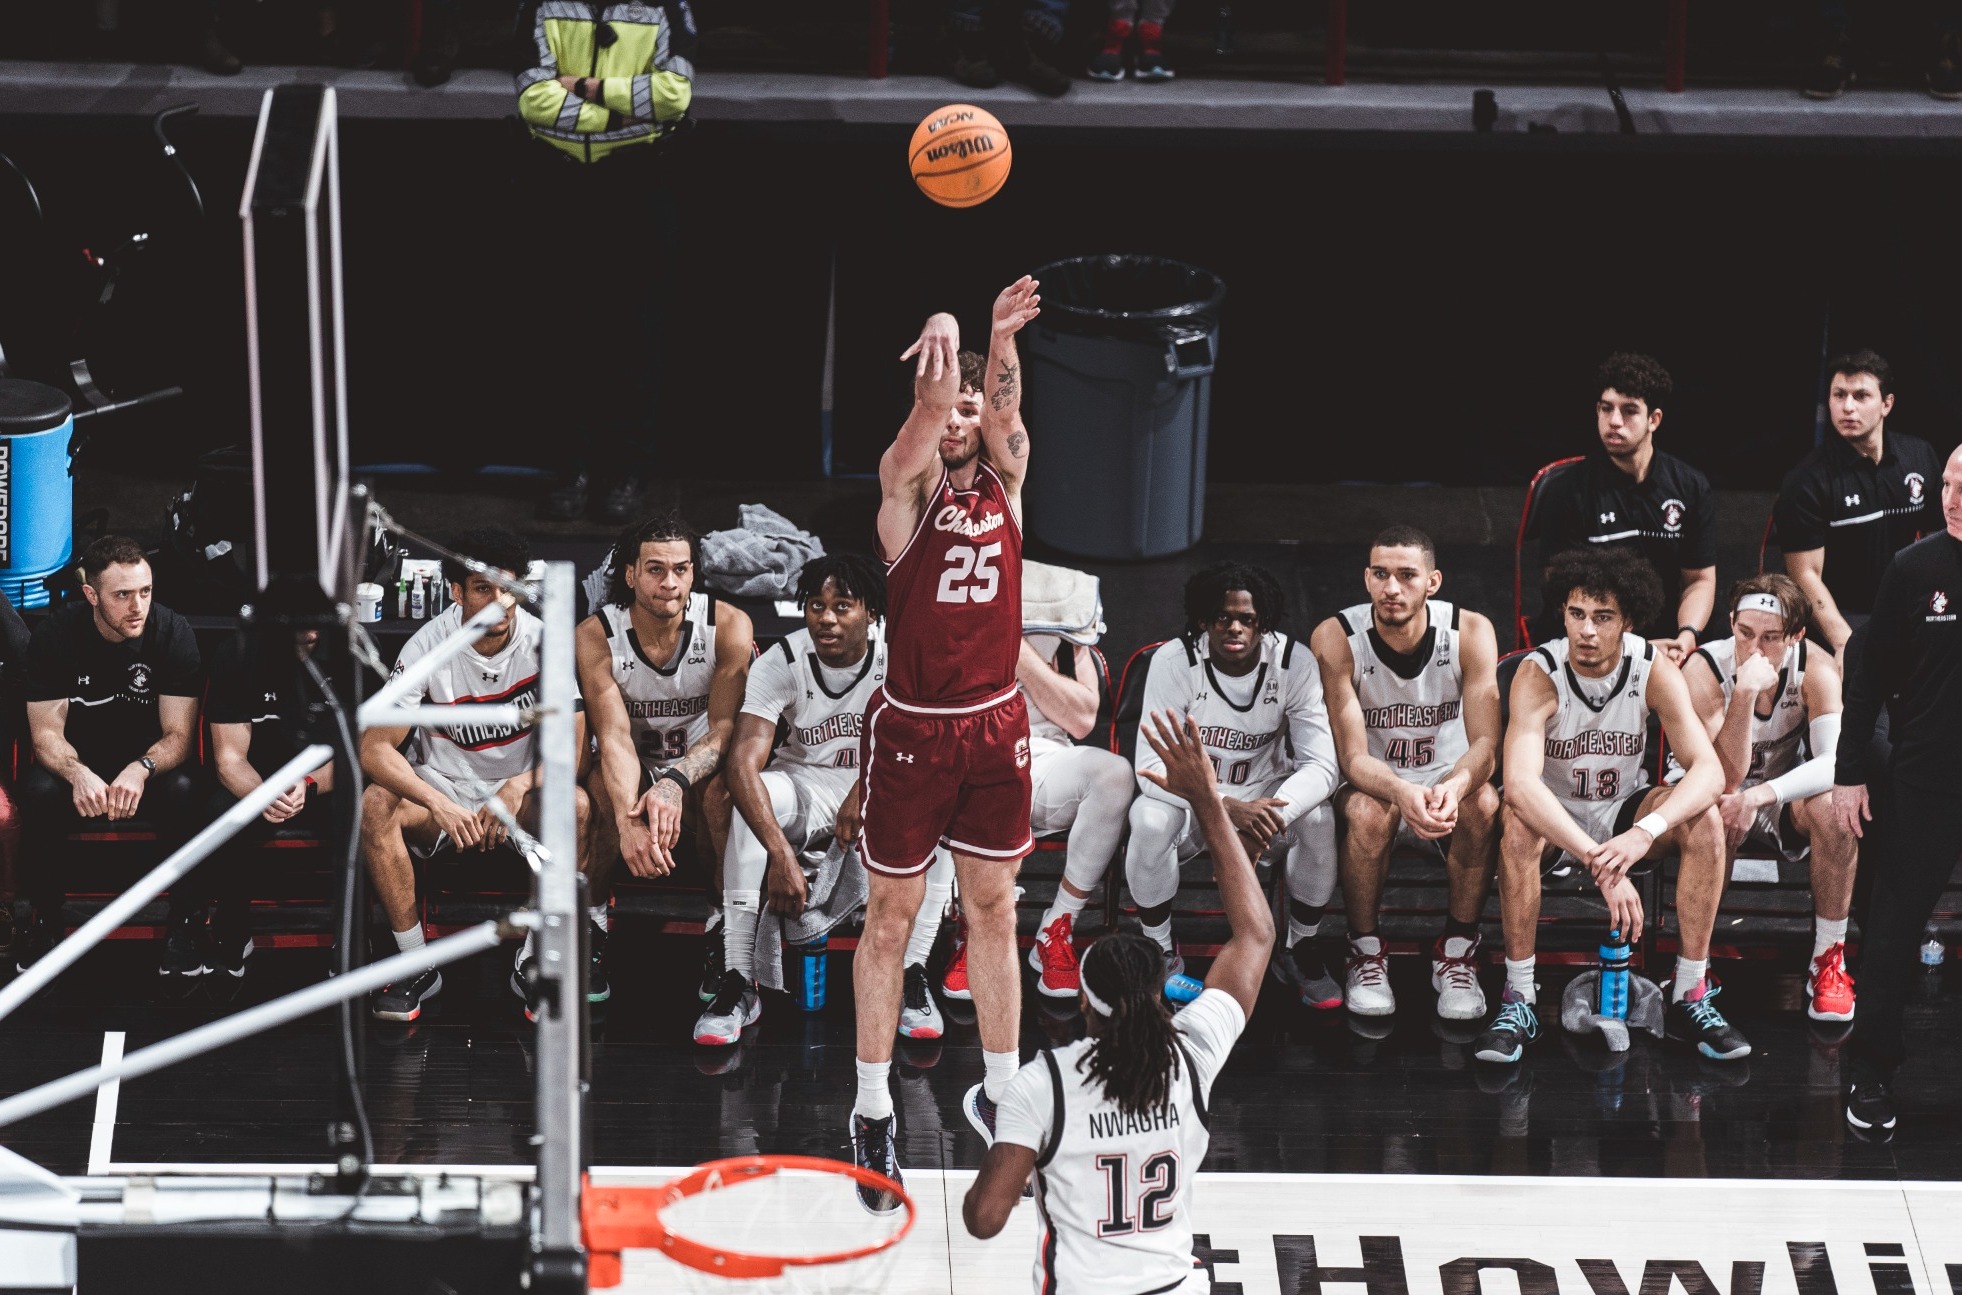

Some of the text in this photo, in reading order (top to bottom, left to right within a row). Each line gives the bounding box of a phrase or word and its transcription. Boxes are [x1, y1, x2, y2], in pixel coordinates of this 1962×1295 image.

[926, 134, 994, 162] Wilson
[936, 540, 1002, 603] 25
[687, 656, 706, 665] CAA
[640, 727, 688, 760] 23
[1384, 736, 1436, 769] 45
[1571, 767, 1621, 800] 13
[1096, 1149, 1181, 1239] 12
